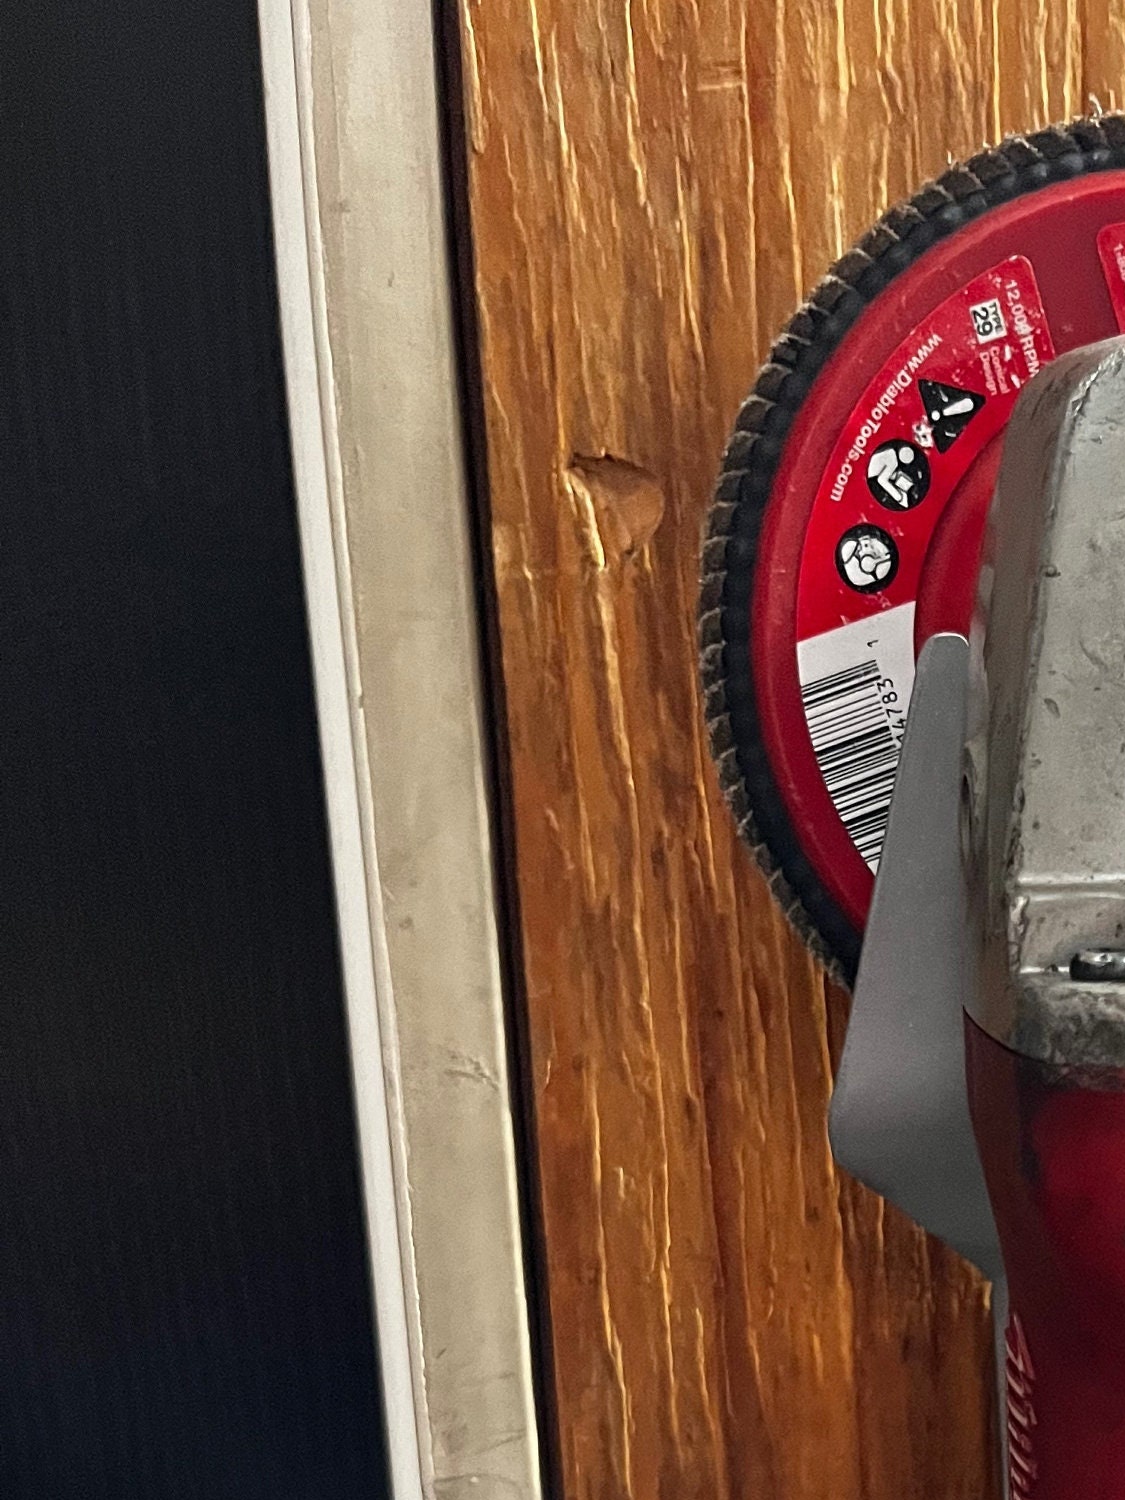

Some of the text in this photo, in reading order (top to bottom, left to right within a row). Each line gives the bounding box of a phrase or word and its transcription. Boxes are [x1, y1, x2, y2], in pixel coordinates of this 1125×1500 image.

[972, 306, 993, 336] 29
[989, 302, 1003, 333] TYPE
[980, 351, 997, 395] Design
[990, 346, 1009, 393] Conical
[1020, 335, 1039, 378] RPM
[831, 334, 942, 502] www.DiabloTools.com
